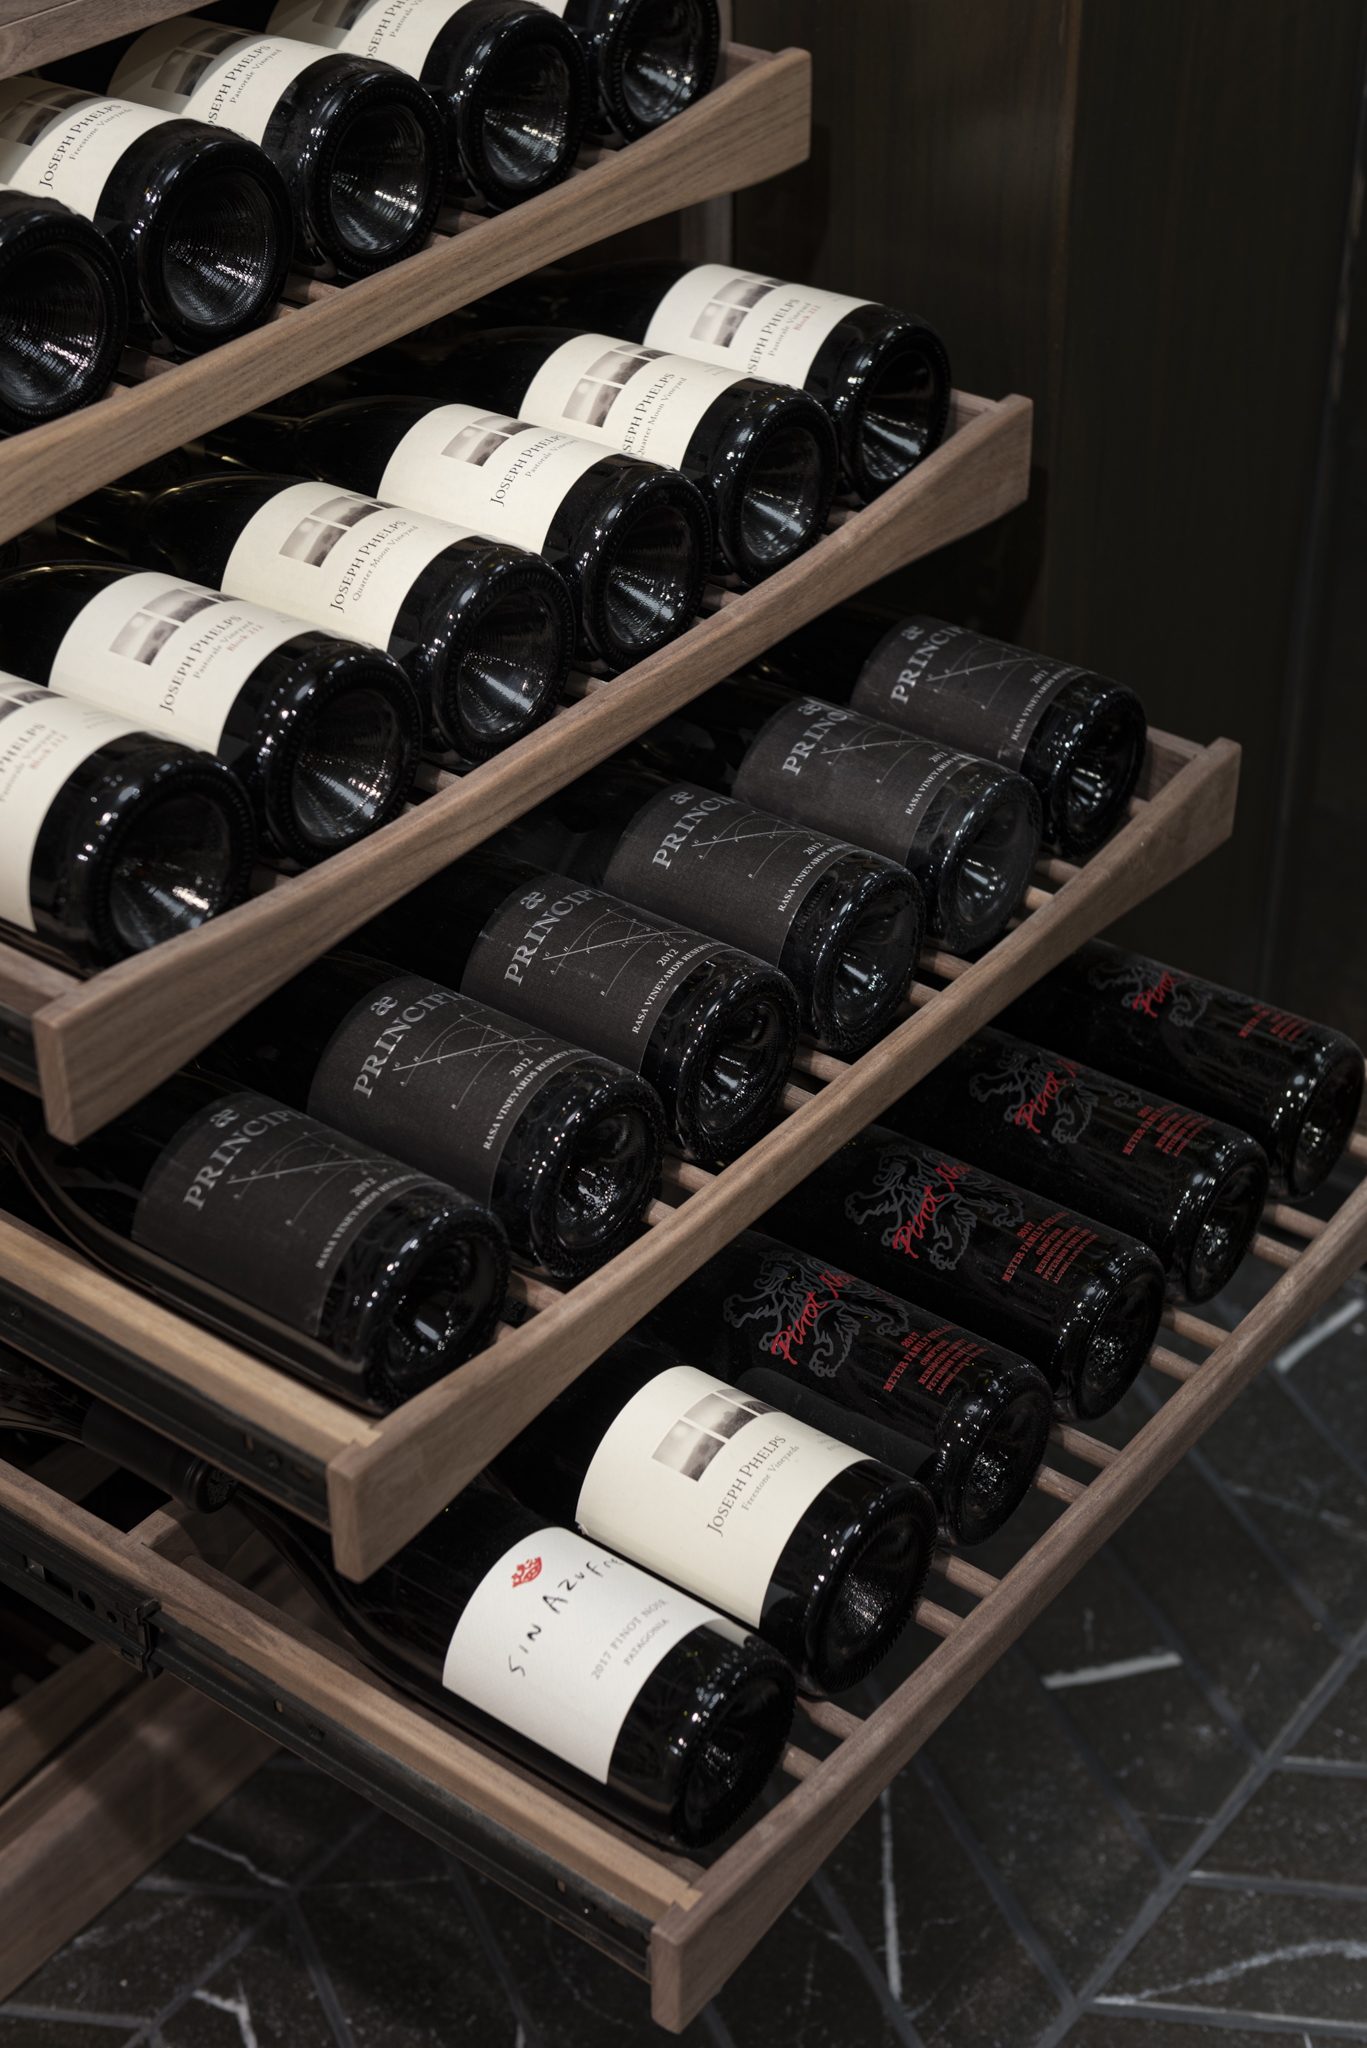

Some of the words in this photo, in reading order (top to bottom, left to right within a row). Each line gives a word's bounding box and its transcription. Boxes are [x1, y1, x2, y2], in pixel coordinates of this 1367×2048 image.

[384, 0, 408, 17] PH
[389, 7, 414, 38] Pastorale
[225, 45, 271, 82] PHELPS
[229, 70, 255, 104] Pastorale
[254, 48, 282, 72] Vineyard
[38, 135, 75, 190] JOSEPH
[70, 104, 122, 134] PHELPS
[68, 128, 99, 161] Freestone
[761, 298, 801, 336] PHELPS
[768, 323, 790, 358] Pastorale
[788, 301, 813, 326] Vineyard
[793, 315, 809, 332] Block
[808, 304, 821, 319] 212
[622, 415, 643, 454] SEPH
[635, 371, 675, 416] PHELPS
[637, 429, 653, 458] Quarter
[647, 402, 665, 427] Moon
[660, 377, 688, 404] Vineyard
[489, 459, 526, 507] JOSEPH
[520, 433, 567, 464] PHELPS
[524, 452, 554, 479] Pastorale
[551, 438, 579, 454] Vineyard
[329, 556, 365, 614] JOSEPH
[358, 519, 407, 557] PHELPS
[352, 569, 374, 602] Quarter
[370, 546, 391, 569] Moon
[387, 524, 419, 547] Vineyard
[159, 653, 197, 715] JOSEPH
[190, 613, 243, 655] PHELPS
[192, 644, 223, 680] Pastorale
[220, 620, 256, 646] Vineyard
[226, 634, 249, 653] Block
[1029, 669, 1050, 686] 2012
[1010, 716, 1027, 742] RASA
[1021, 677, 1055, 718] VINEYARDS
[928, 751, 949, 765] 2012
[905, 793, 923, 816] RASA
[918, 759, 953, 794] VINEYARDS
[803, 842, 825, 856] 2012
[777, 888, 796, 913] RASA
[791, 851, 830, 888] VINEYARDS
[656, 948, 679, 967] 2012
[630, 1008, 649, 1035] RASA
[643, 959, 685, 1007] VINEYARDS
[681, 942, 713, 962] RESERVE
[508, 1057, 534, 1078] 2012
[483, 1123, 501, 1150] RASA
[495, 1070, 539, 1120] VINEYARDS
[534, 1049, 572, 1072] RESERVE
[1015, 1070, 1067, 1134] Pinot
[1122, 1128, 1146, 1156] MEYER
[349, 1177, 378, 1197] 2012
[315, 1240, 338, 1270] RASA
[331, 1190, 381, 1239] VINEYARDS
[892, 1184, 945, 1260] Pinot
[1016, 1221, 1036, 1239] 2017
[1035, 1227, 1064, 1256] COMPTCHE
[1001, 1251, 1026, 1283] MEYER
[1019, 1225, 1046, 1253] FAMILY
[1034, 1239, 1065, 1275] MENDOCINO
[1060, 1225, 1081, 1242] COUNTY
[1042, 1247, 1070, 1281] PETERSON
[1065, 1228, 1091, 1249] VINEYARD
[1053, 1261, 1072, 1284] ALCOHOL
[771, 1290, 828, 1366] Pinot
[900, 1331, 921, 1349] 2017
[919, 1339, 950, 1366] COMPTCHE
[882, 1360, 909, 1393] MEYER
[902, 1336, 931, 1362] FAMILY
[917, 1351, 950, 1385] MENDOCINO
[925, 1358, 955, 1392] PETERSON
[951, 1342, 979, 1361] VINEYARD
[936, 1372, 956, 1396] ALCOHOL
[705, 1477, 747, 1538] JOSEPH
[739, 1435, 787, 1479] PHELPS
[741, 1472, 772, 1512] Freestone
[768, 1444, 800, 1475] Vineyards
[508, 1623, 543, 1677] SIN
[591, 1651, 613, 1681] 2017
[610, 1616, 642, 1651] PINOT
[642, 1598, 670, 1618] NOIR
[623, 1618, 670, 1668] PATAGONIA
